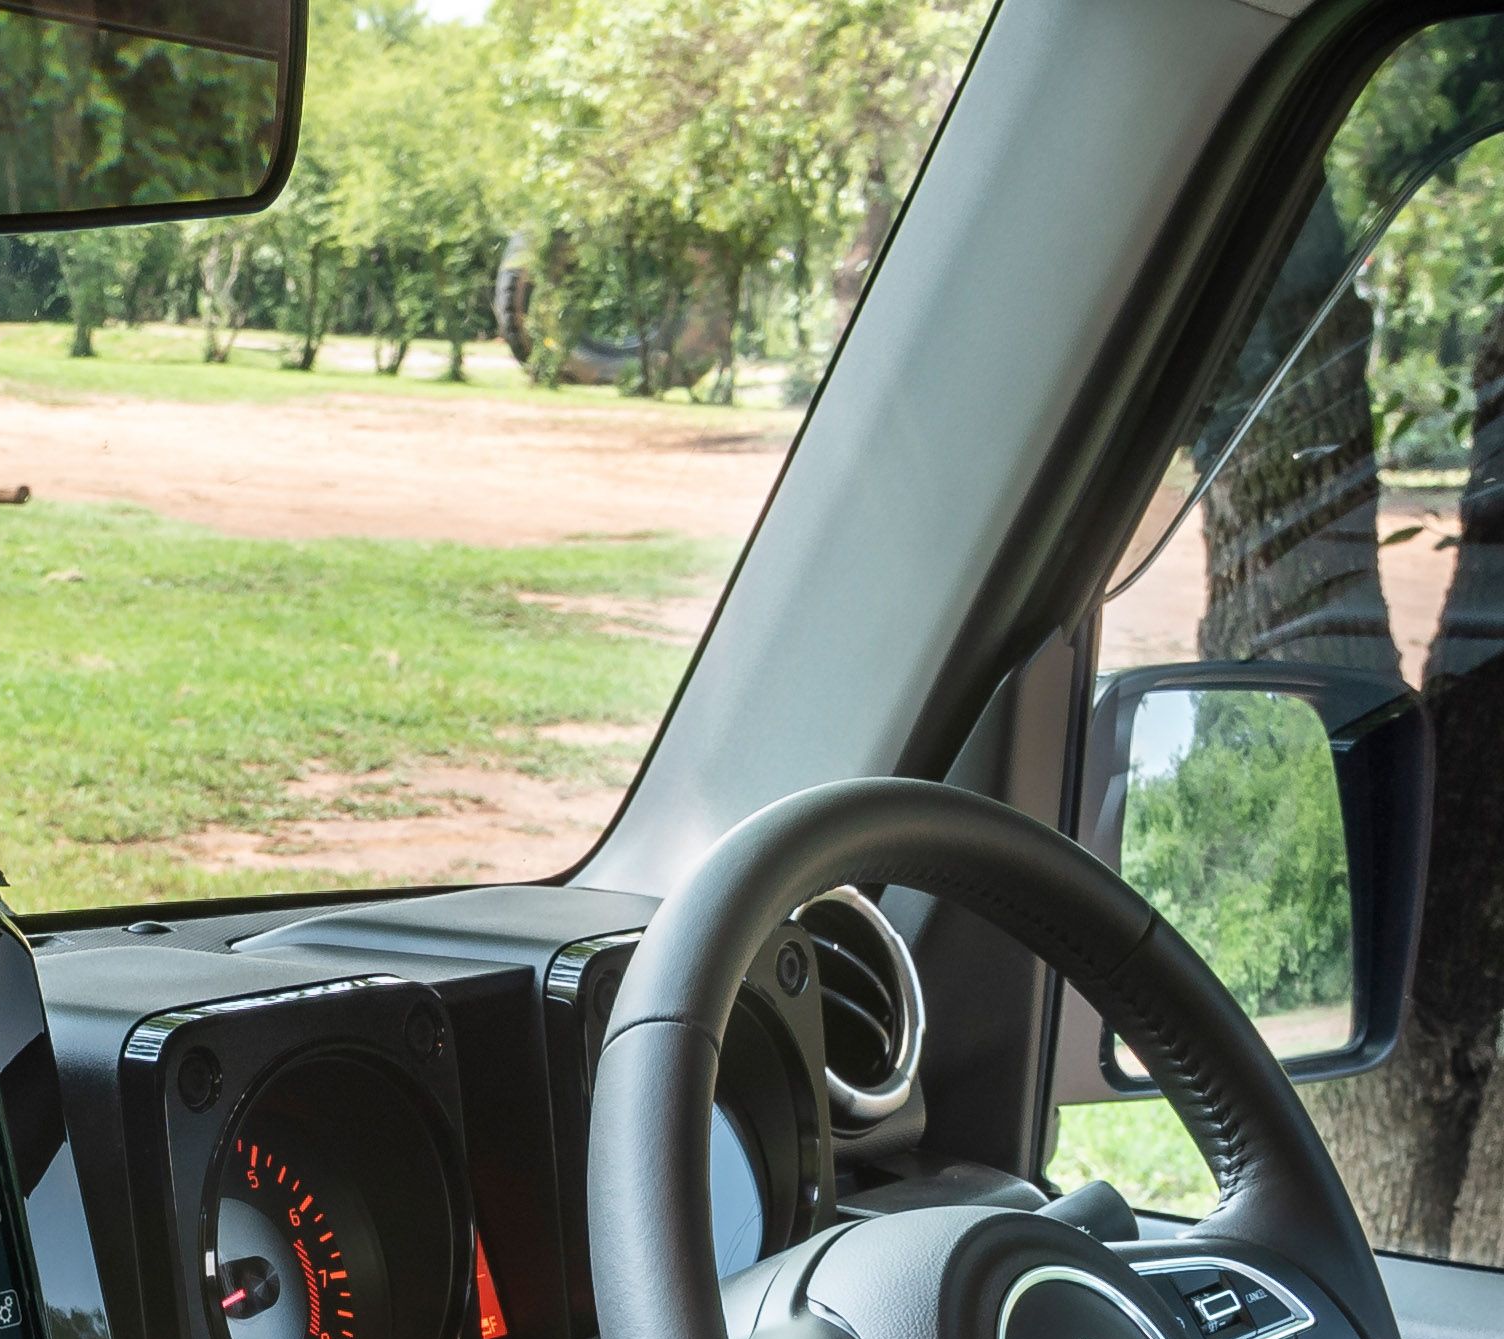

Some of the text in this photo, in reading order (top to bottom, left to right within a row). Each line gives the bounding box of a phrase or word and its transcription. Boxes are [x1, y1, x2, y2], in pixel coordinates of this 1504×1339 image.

[247, 1170, 260, 1189] 5
[289, 1207, 300, 1227] 6
[318, 1269, 327, 1288] 7
